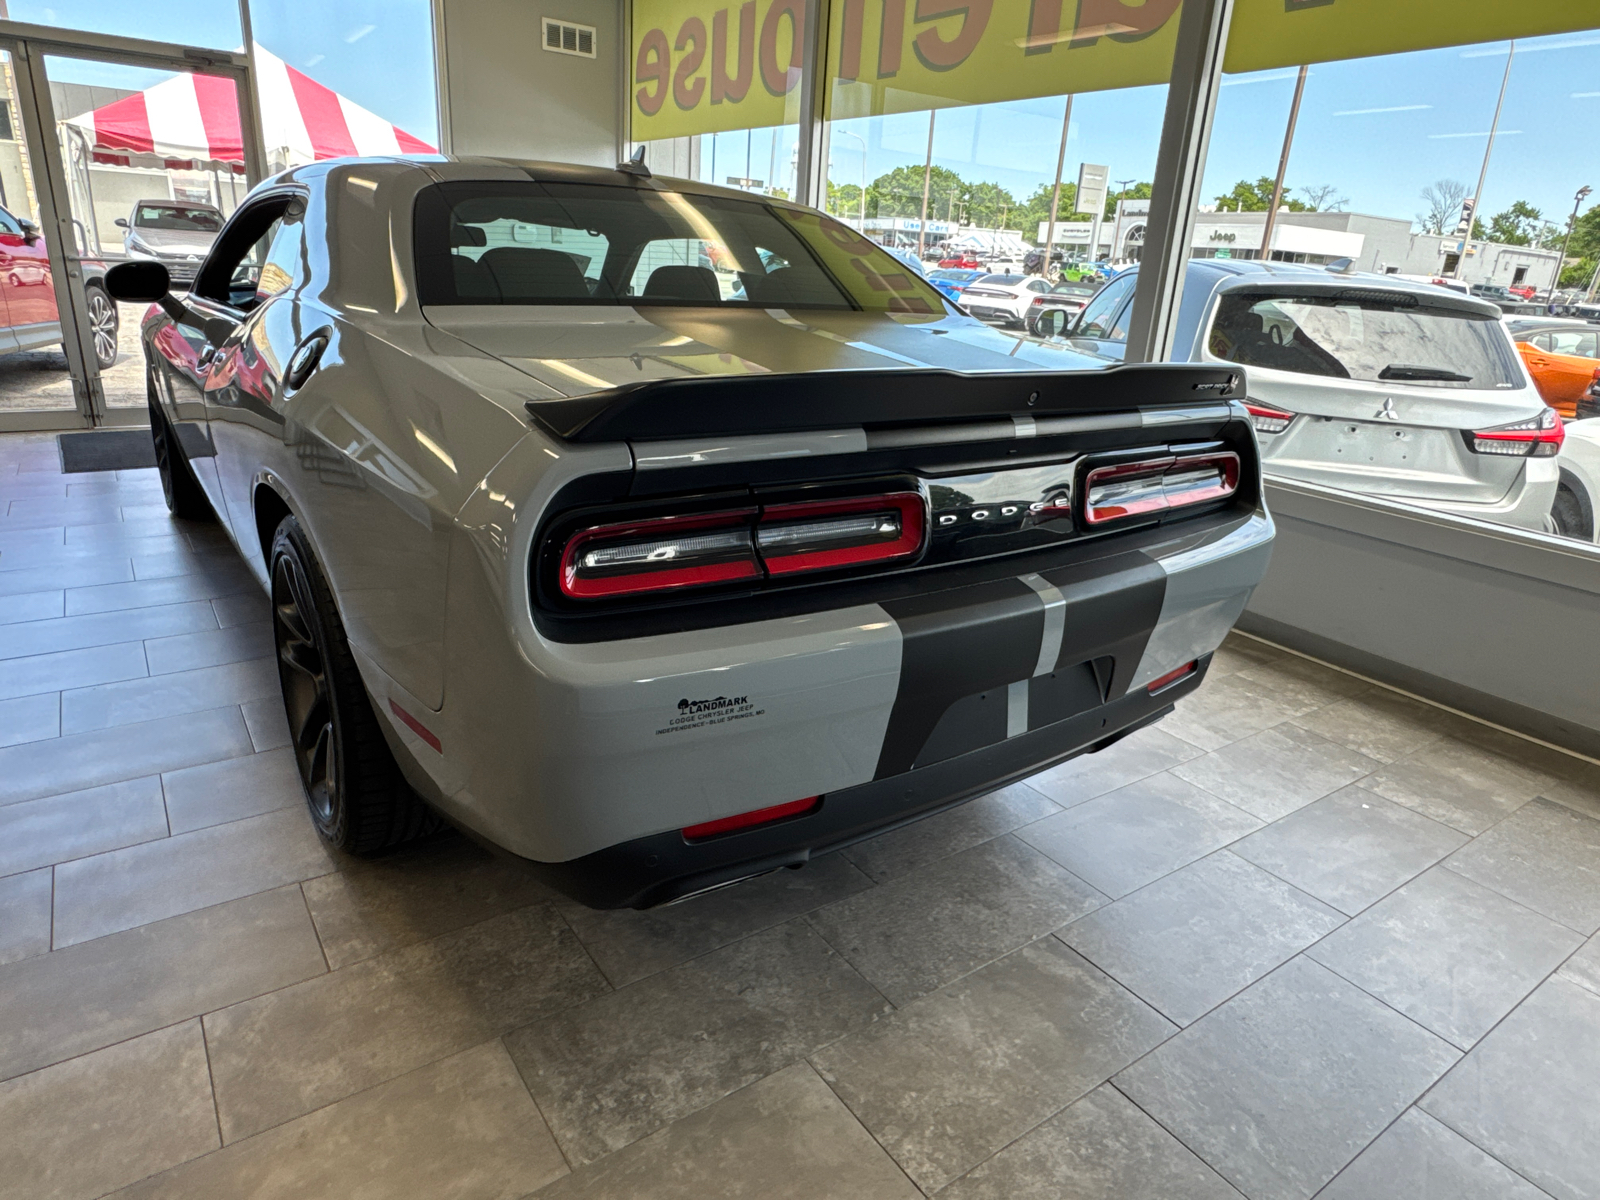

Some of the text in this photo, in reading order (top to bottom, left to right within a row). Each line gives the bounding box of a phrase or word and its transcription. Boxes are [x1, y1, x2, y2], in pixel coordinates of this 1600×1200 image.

[903, 221, 921, 230] Use
[1209, 229, 1236, 244] Jeep
[939, 498, 1068, 525] DODGE
[689, 695, 748, 714] LANDMARK
[697, 707, 735, 720] CHRYSLER
[736, 703, 754, 713] JEEP
